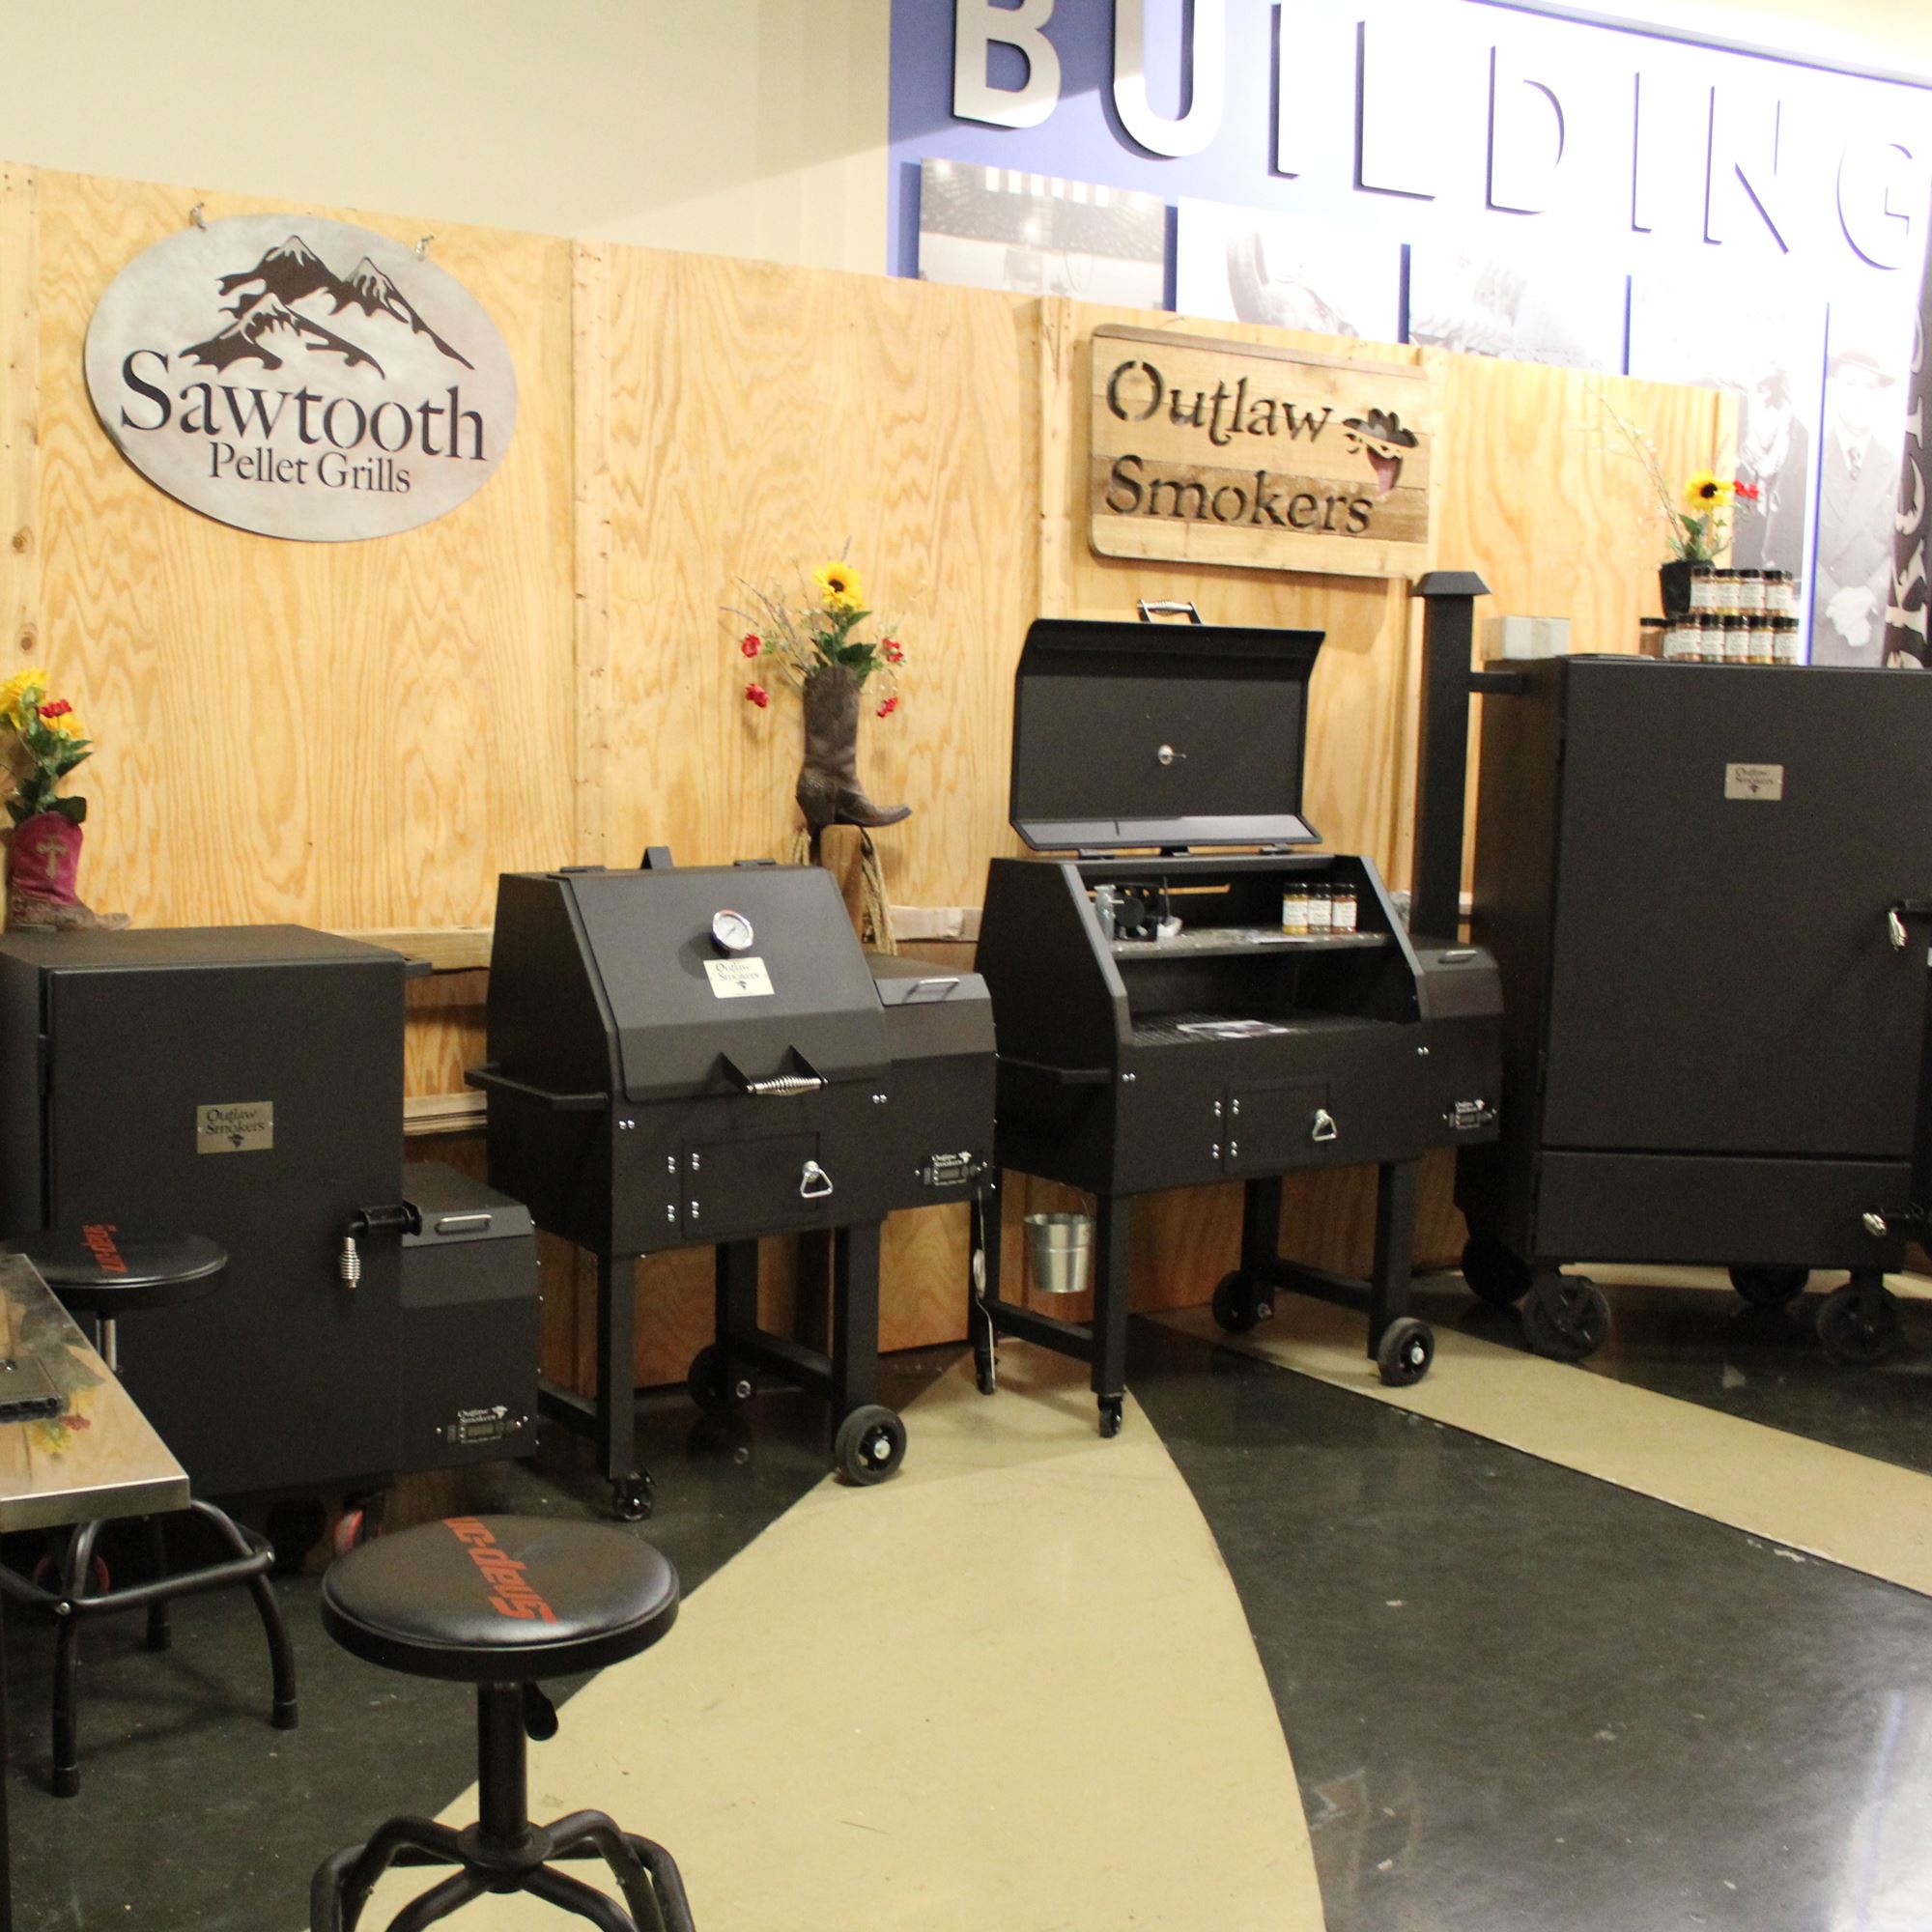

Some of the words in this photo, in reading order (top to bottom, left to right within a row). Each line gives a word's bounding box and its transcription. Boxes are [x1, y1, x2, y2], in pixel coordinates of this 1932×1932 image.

[952, 0, 1922, 270] BUILDING
[120, 349, 488, 462] Sawtooth
[1106, 359, 1334, 446] Outlaw
[209, 441, 308, 485] Pellet
[318, 451, 412, 495] Grills
[1106, 454, 1374, 533] Smokers
[206, 1108, 257, 1122] Outlaw
[206, 1122, 265, 1135] Smokers
[441, 1516, 558, 1625] Snap-on
